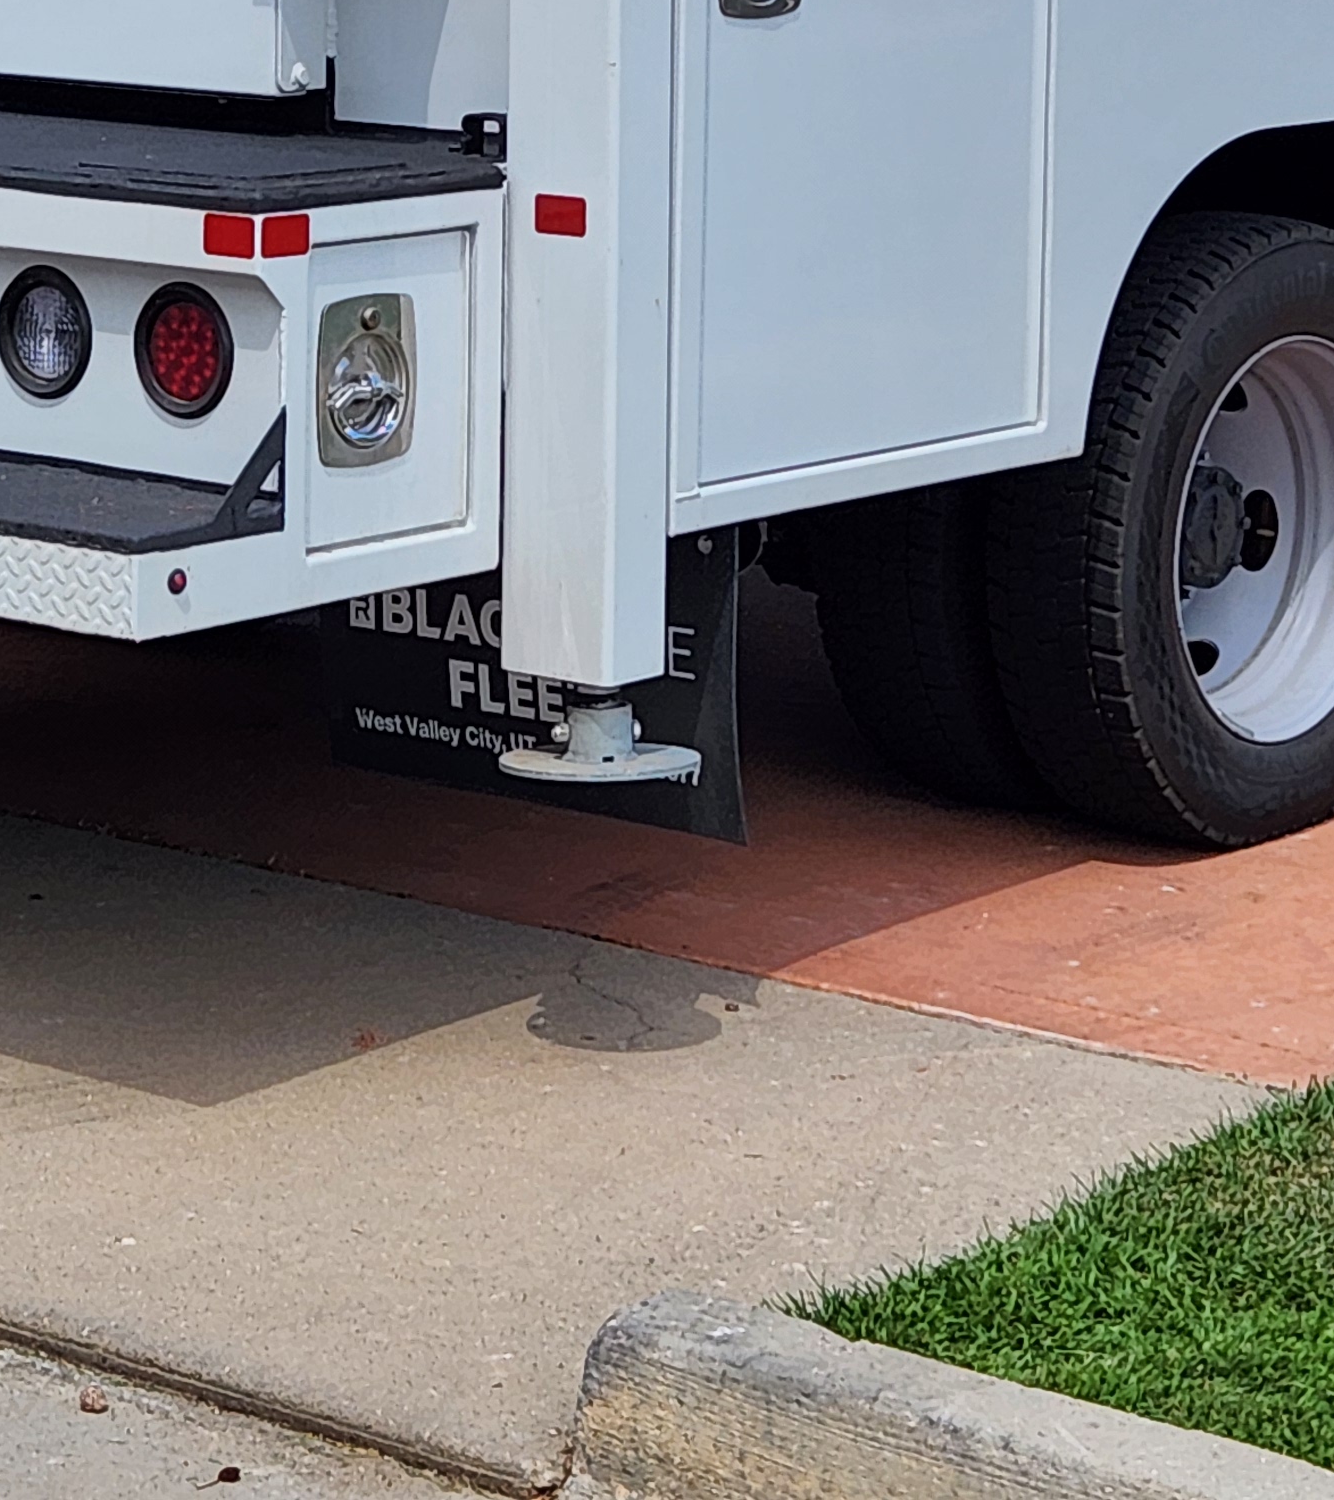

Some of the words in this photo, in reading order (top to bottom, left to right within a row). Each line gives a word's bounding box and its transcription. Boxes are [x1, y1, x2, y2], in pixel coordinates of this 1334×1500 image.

[448, 658, 573, 723] FLEE
[355, 707, 404, 735] West
[405, 715, 461, 747] Valley
[465, 725, 507, 753] City,
